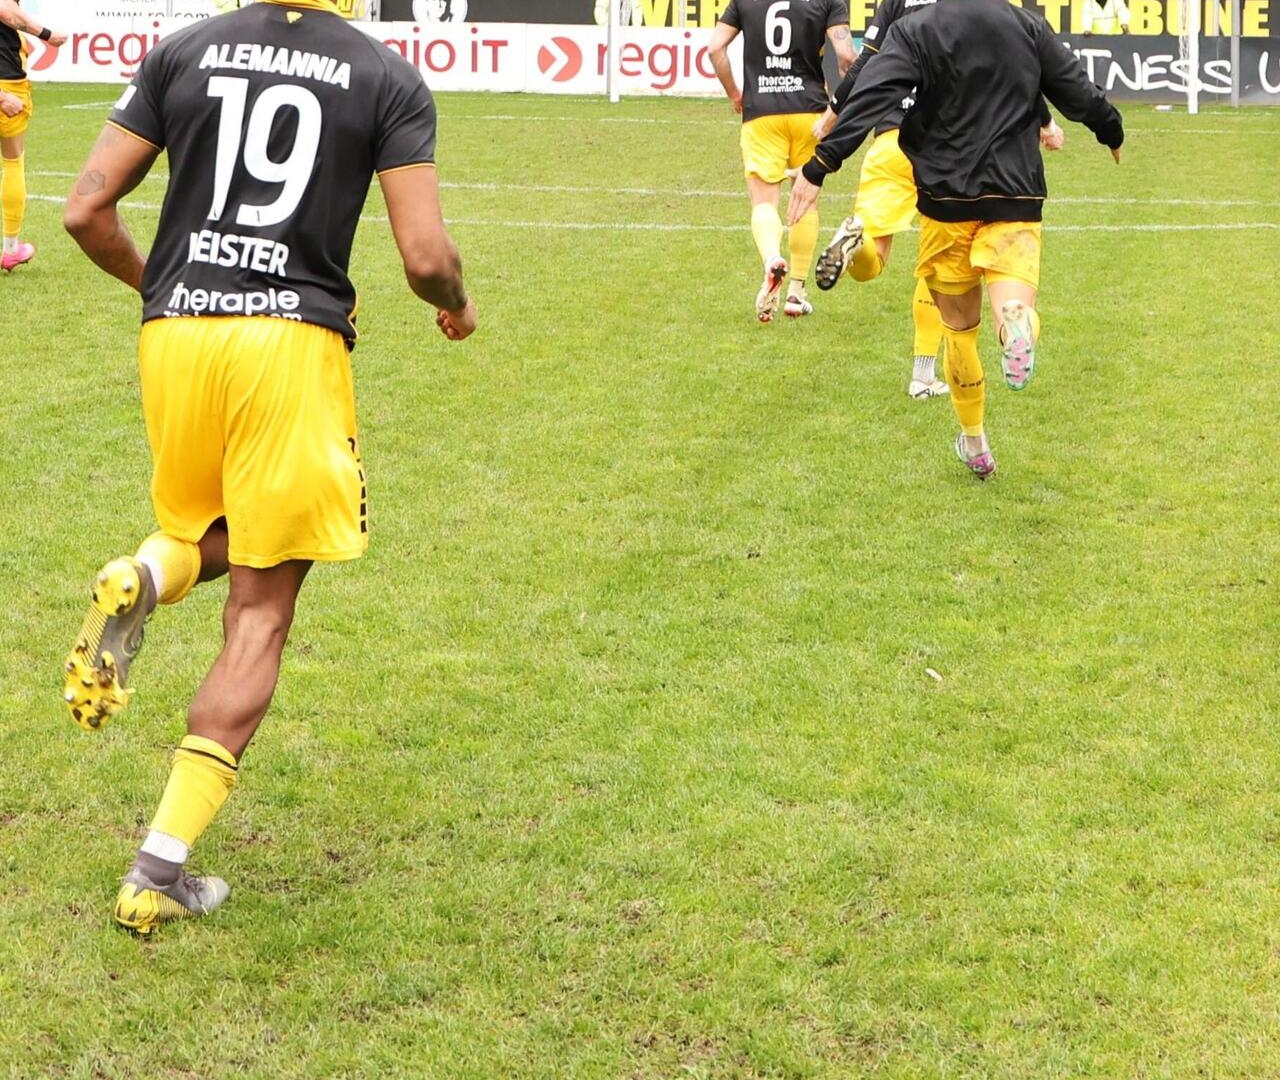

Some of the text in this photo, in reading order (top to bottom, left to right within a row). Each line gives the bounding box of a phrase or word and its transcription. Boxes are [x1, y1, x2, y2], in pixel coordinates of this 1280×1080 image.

[765, 1, 793, 55] 6
[199, 42, 351, 91] ALEMANNIA
[206, 76, 323, 228] 19
[167, 284, 301, 317] therapie
